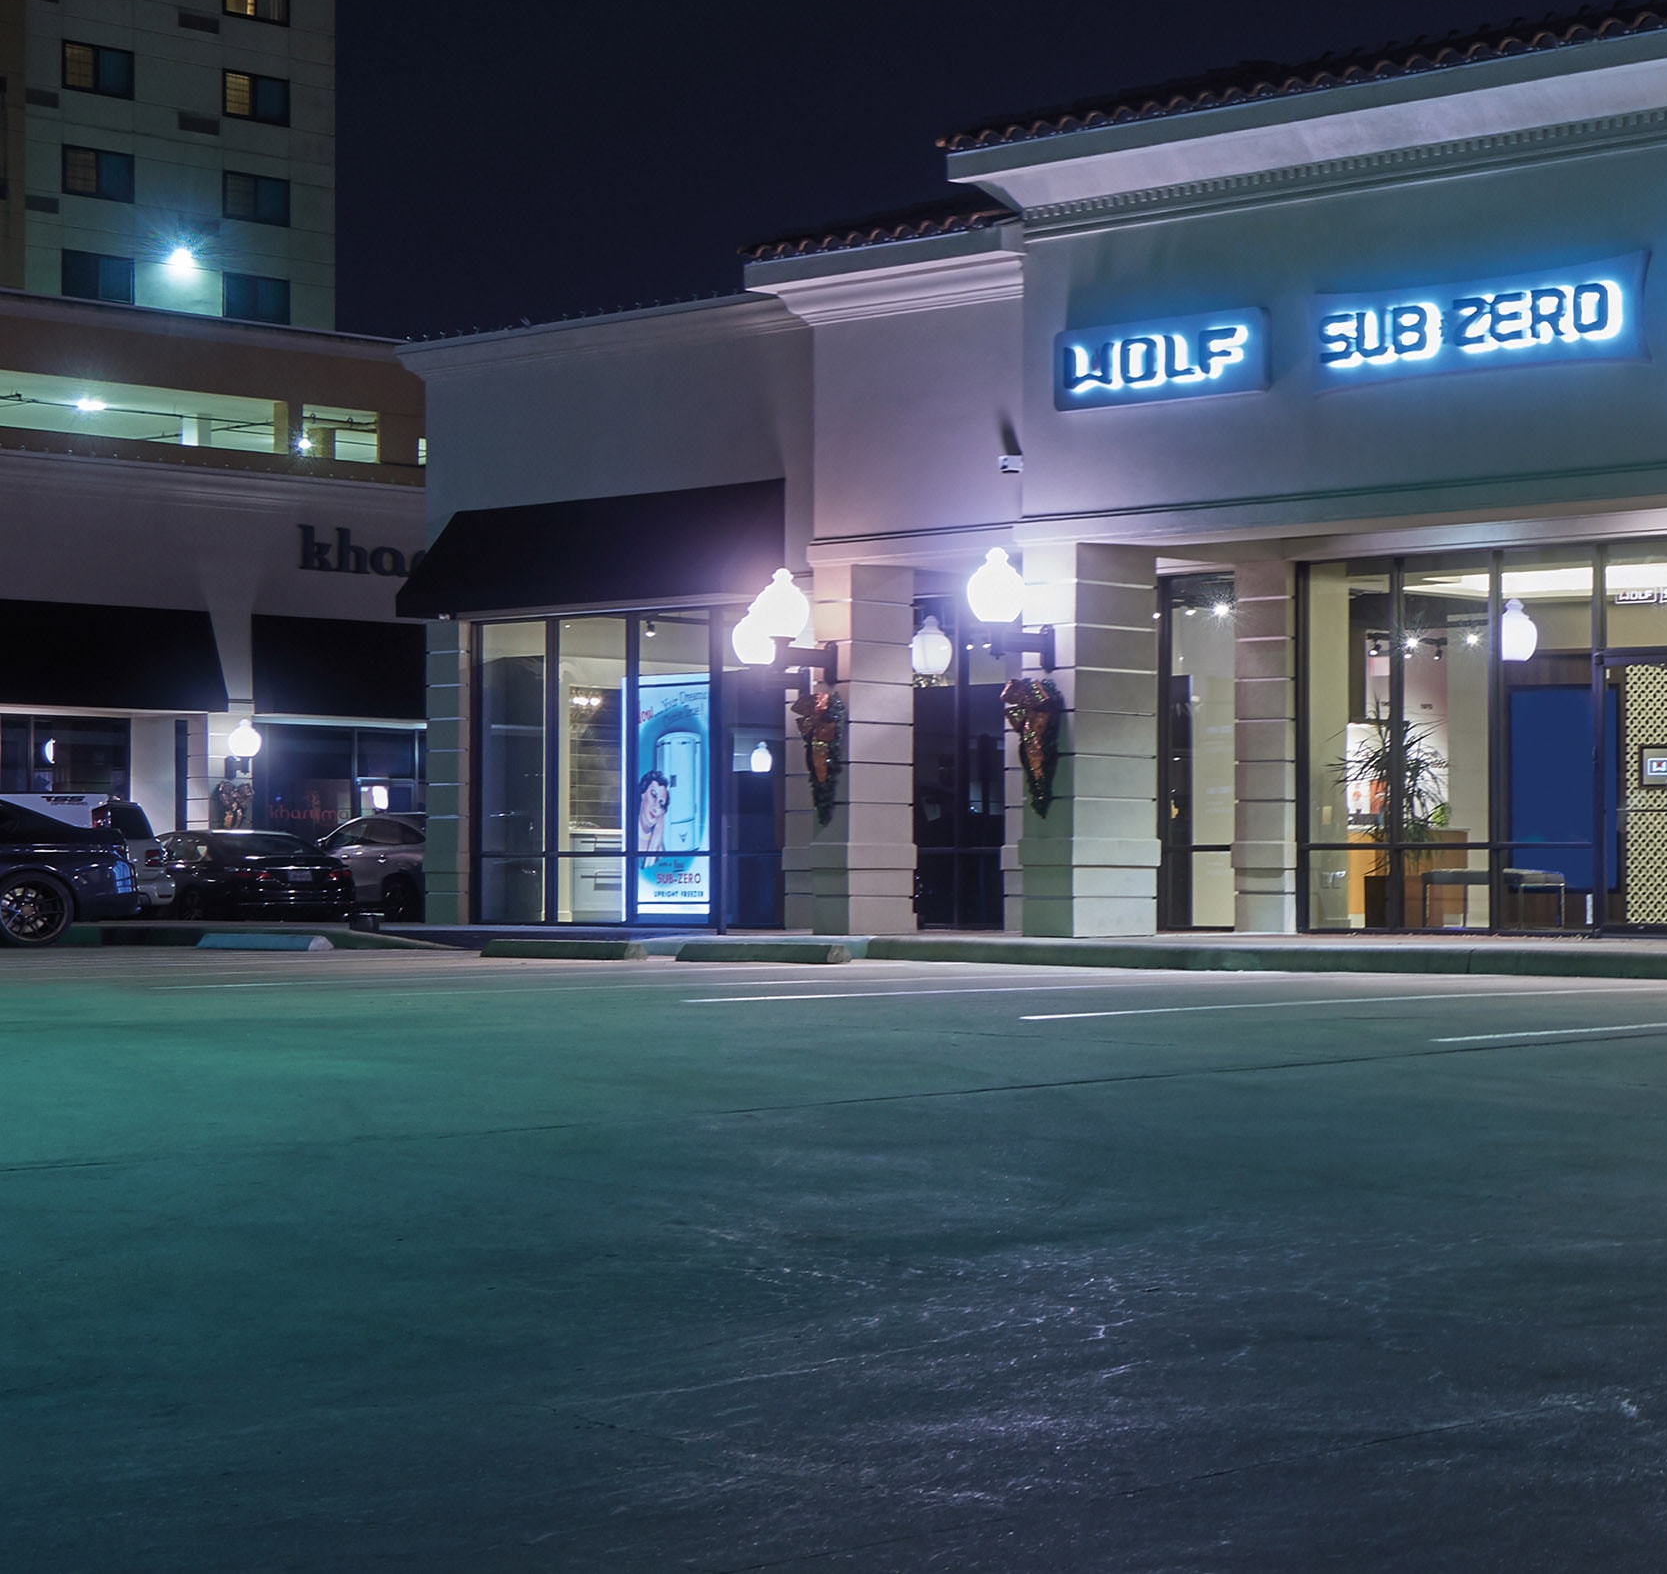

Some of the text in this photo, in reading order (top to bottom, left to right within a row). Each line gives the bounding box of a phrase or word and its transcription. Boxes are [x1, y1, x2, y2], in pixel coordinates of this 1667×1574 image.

[1318, 281, 1617, 367] SUB ZERO
[1063, 327, 1246, 391] WOLF
[1618, 589, 1653, 601] WOLF
[656, 872, 702, 884] SUB-ZERO
